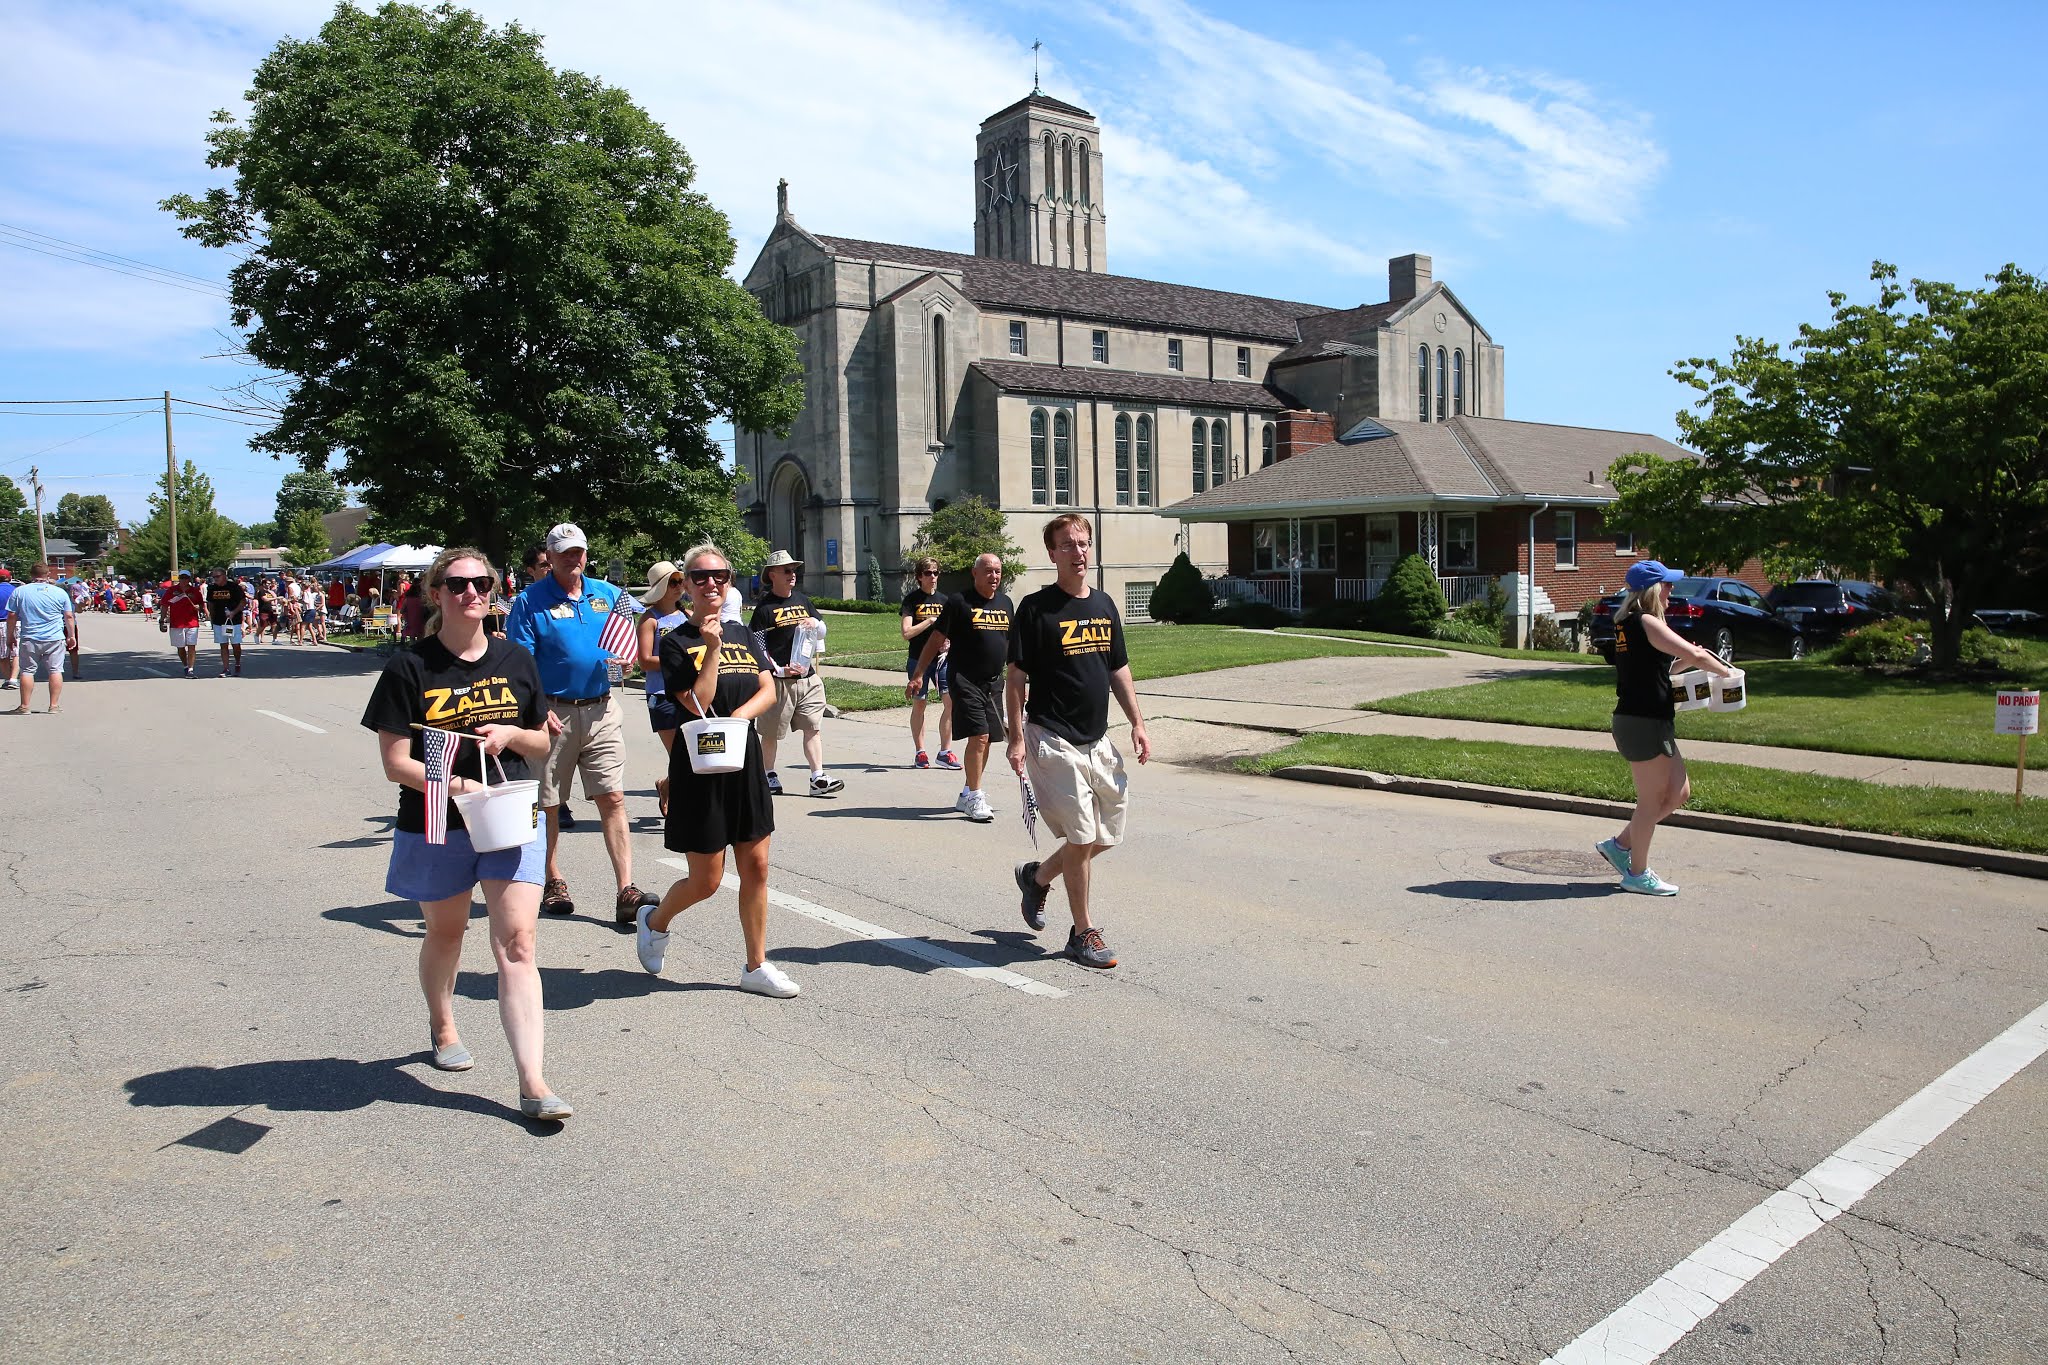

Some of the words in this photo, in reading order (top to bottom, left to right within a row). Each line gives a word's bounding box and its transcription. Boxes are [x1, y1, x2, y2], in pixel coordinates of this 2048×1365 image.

[773, 607, 809, 622] ZALLA
[916, 603, 942, 615] ZALL
[971, 608, 1009, 624] ZALLA
[453, 687, 472, 696] KEEP
[491, 676, 508, 685] Dan
[424, 687, 518, 721] ZALLA
[1998, 695, 2011, 706] NO
[2013, 695, 2040, 706] PARK
[479, 712, 501, 722] CIRCUIT
[501, 710, 519, 719] JUDGE
[698, 739, 725, 747] ZALLA
